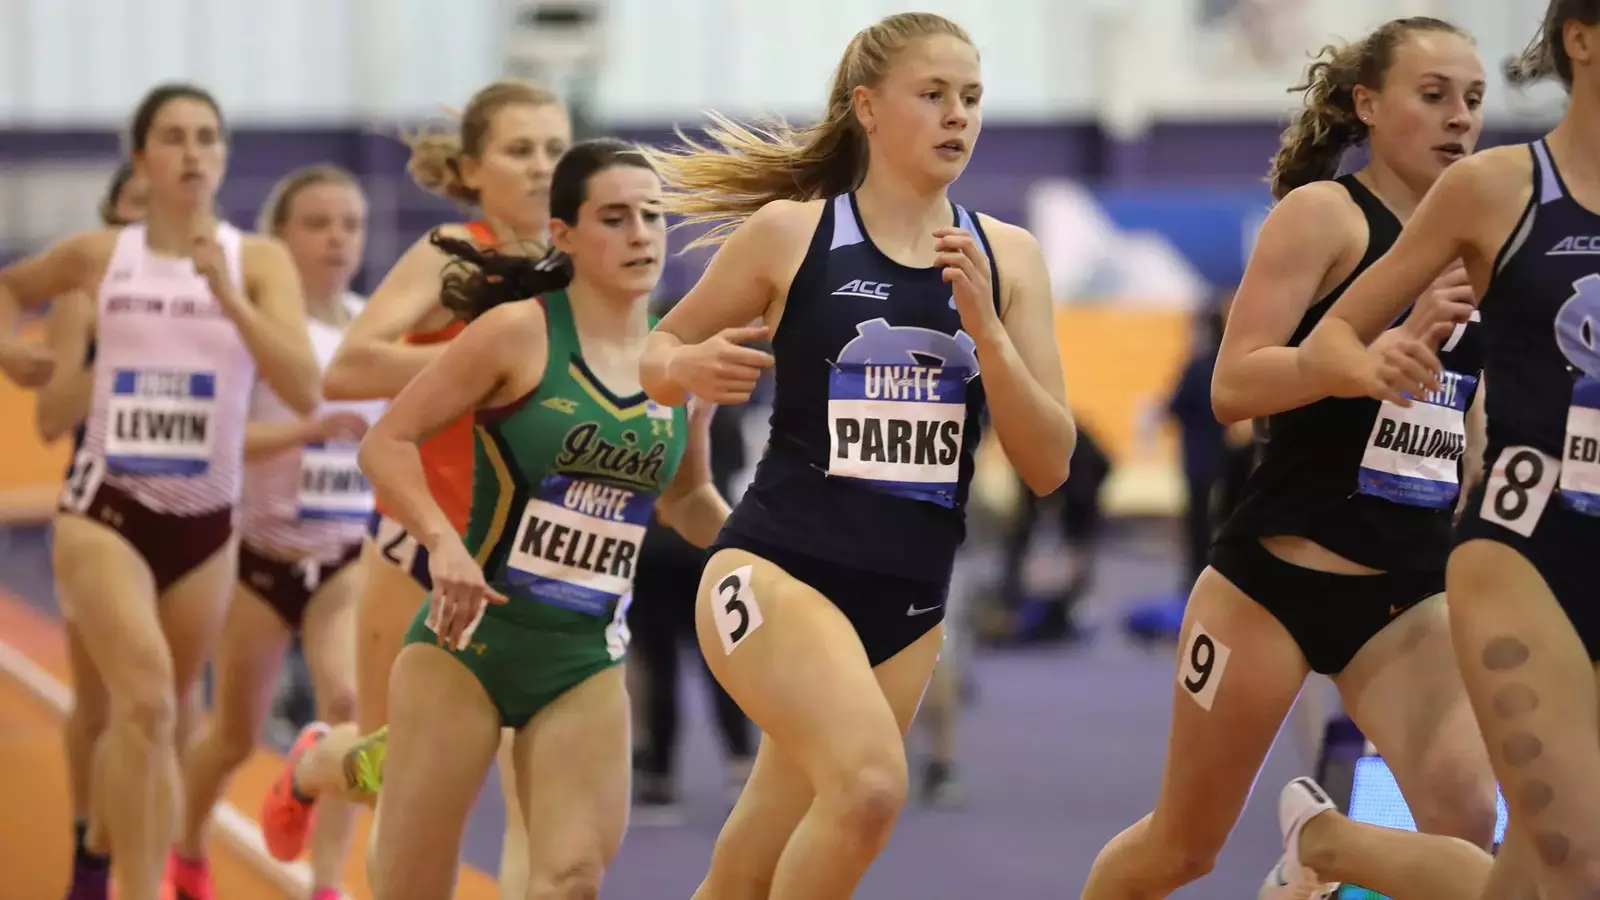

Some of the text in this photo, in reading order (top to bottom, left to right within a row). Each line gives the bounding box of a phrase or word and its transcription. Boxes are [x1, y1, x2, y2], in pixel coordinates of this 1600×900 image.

[834, 279, 893, 297] ACC
[865, 366, 943, 401] UNITE
[116, 408, 207, 444] LEWIN
[836, 418, 960, 466] PARKS
[1569, 436, 1600, 464] ED
[555, 421, 668, 484] Irish
[563, 480, 634, 521] UNITE
[1494, 450, 1544, 521] 8
[520, 516, 636, 580] KELLER
[718, 574, 750, 644] 3
[1185, 634, 1215, 694] 9
